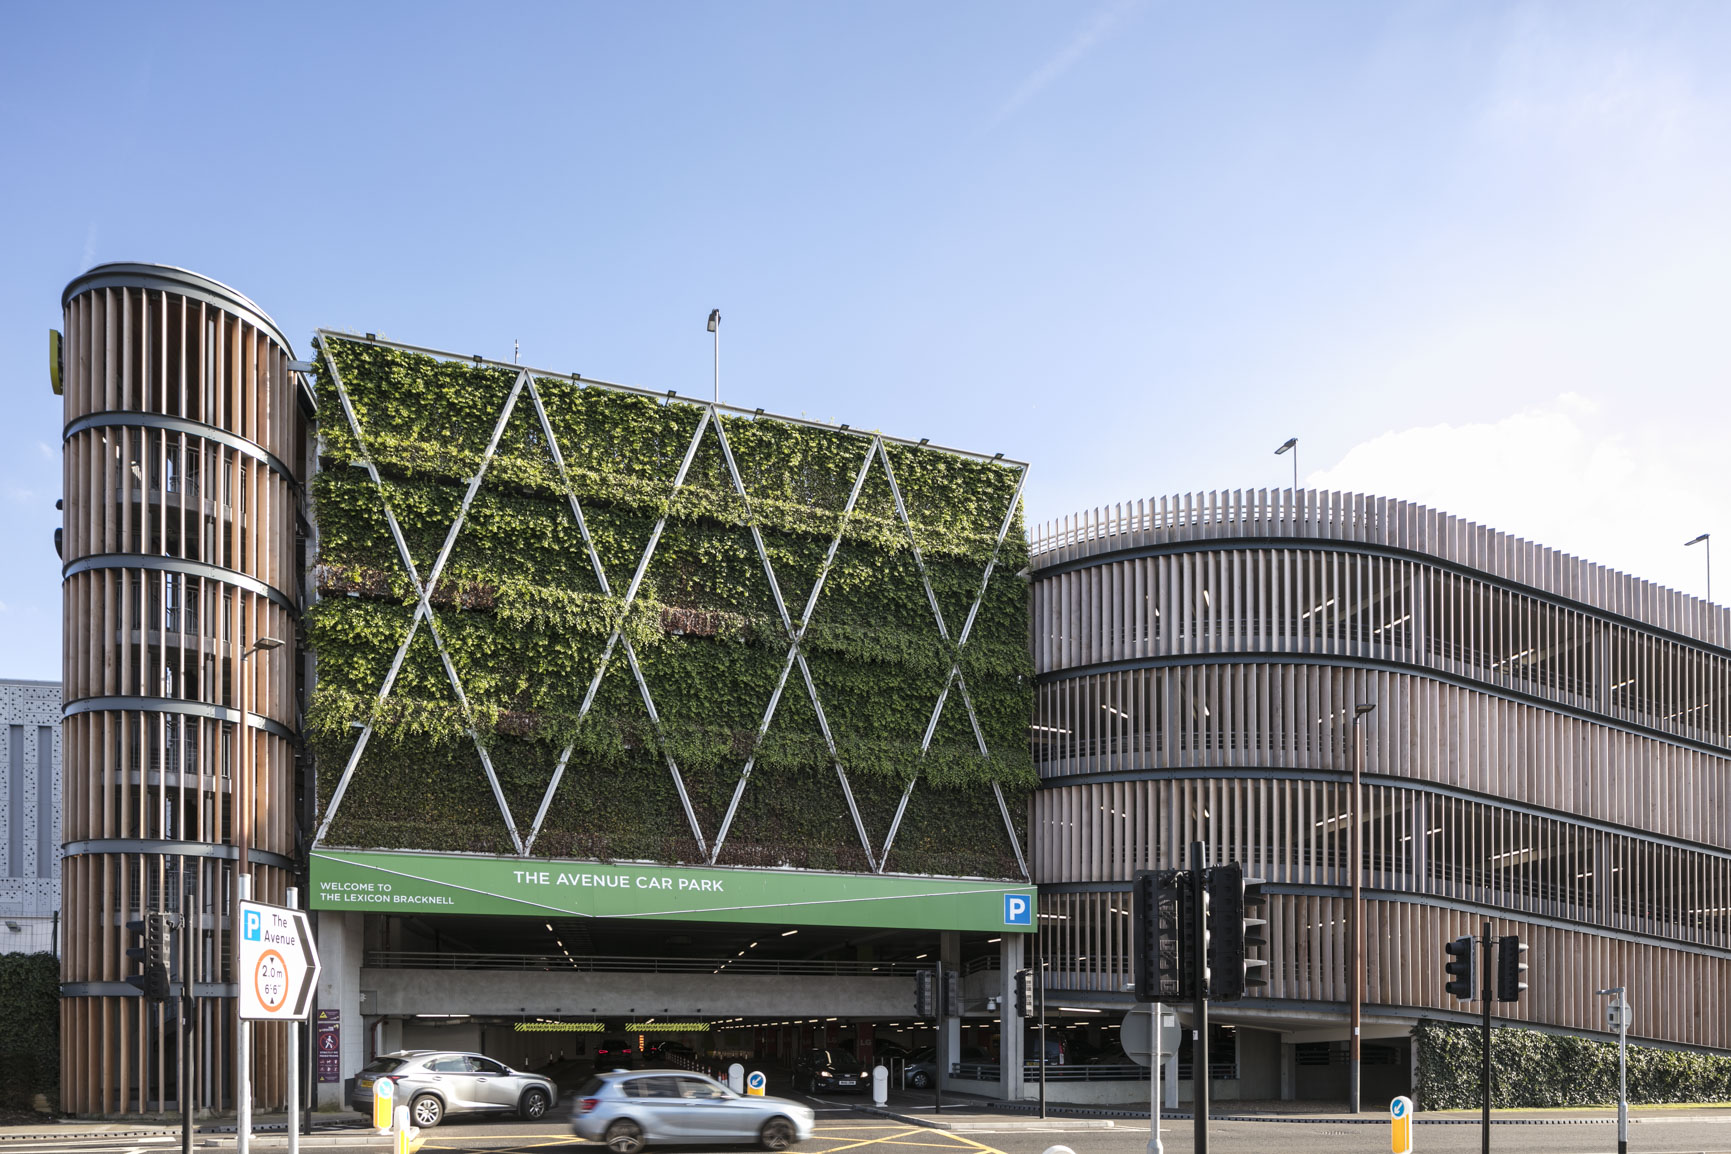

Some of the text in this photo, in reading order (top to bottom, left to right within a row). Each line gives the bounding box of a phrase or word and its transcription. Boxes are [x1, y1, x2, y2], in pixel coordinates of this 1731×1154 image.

[320, 882, 392, 892] WELCOME TO
[514, 871, 724, 892] THE AVENUE CAR PARK
[320, 893, 455, 905] THE LEXICON BRACKNELL
[1009, 898, 1026, 921] P
[247, 913, 259, 939] P
[272, 914, 288, 928] The
[264, 930, 295, 946] Avenue
